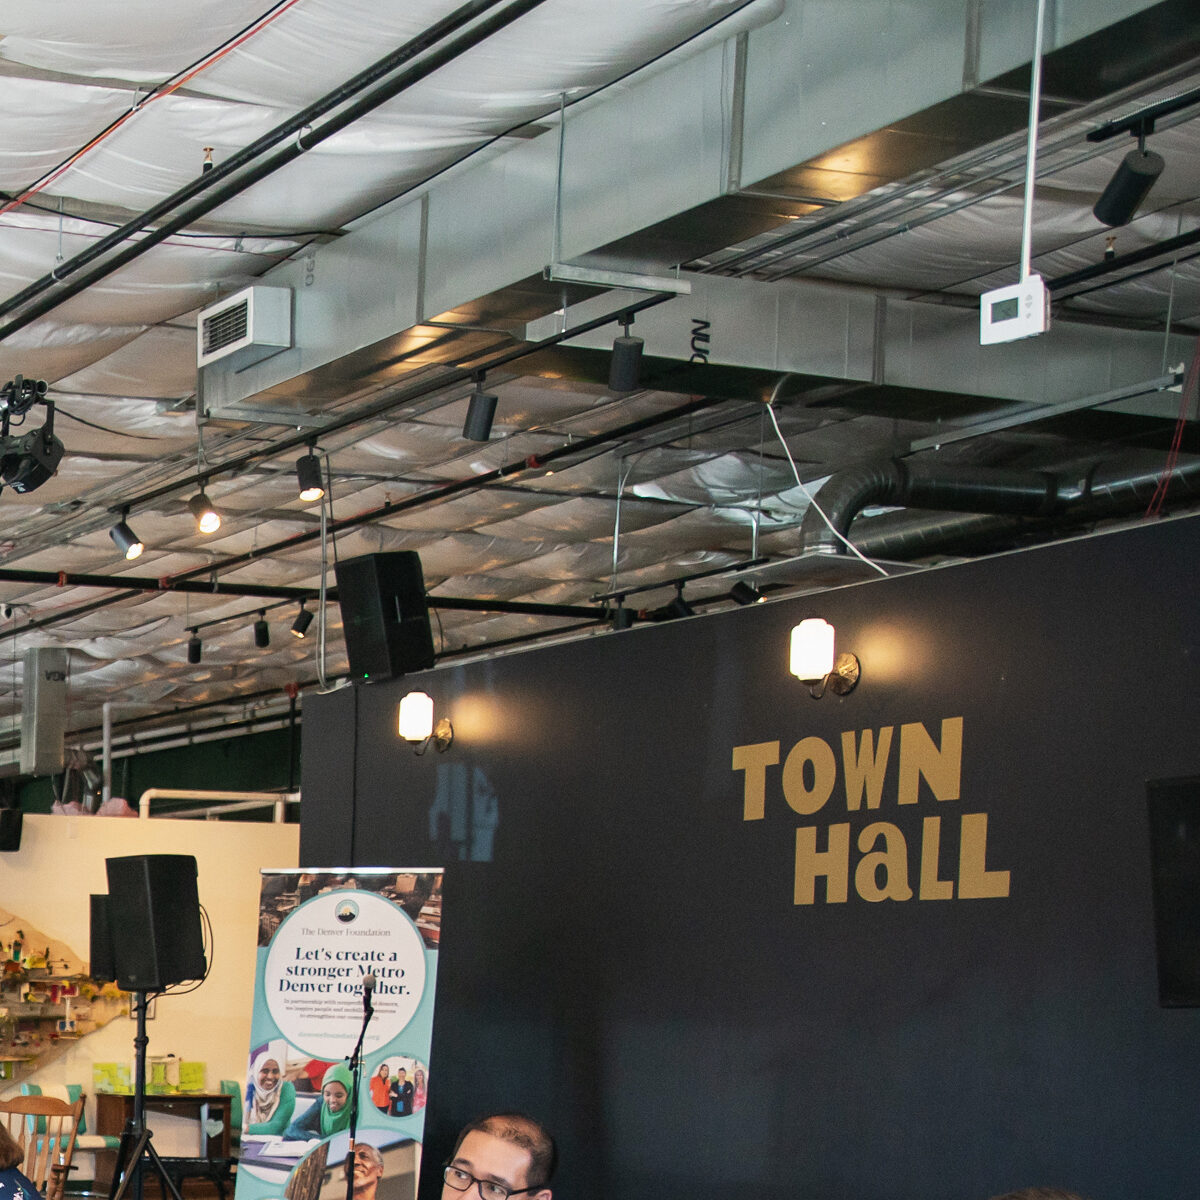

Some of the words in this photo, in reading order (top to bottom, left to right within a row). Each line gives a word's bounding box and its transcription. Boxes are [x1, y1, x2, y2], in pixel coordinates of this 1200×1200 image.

[731, 716, 964, 821] TOWN
[301, 927, 315, 936] The
[317, 927, 343, 937] Denver
[345, 928, 391, 937] Foundation
[295, 947, 332, 961] Let's
[335, 950, 385, 962] create
[388, 951, 398, 962] a
[286, 965, 353, 980] stronger
[357, 964, 405, 978] Metro
[279, 978, 333, 993] Denver
[337, 980, 411, 997] togther.
